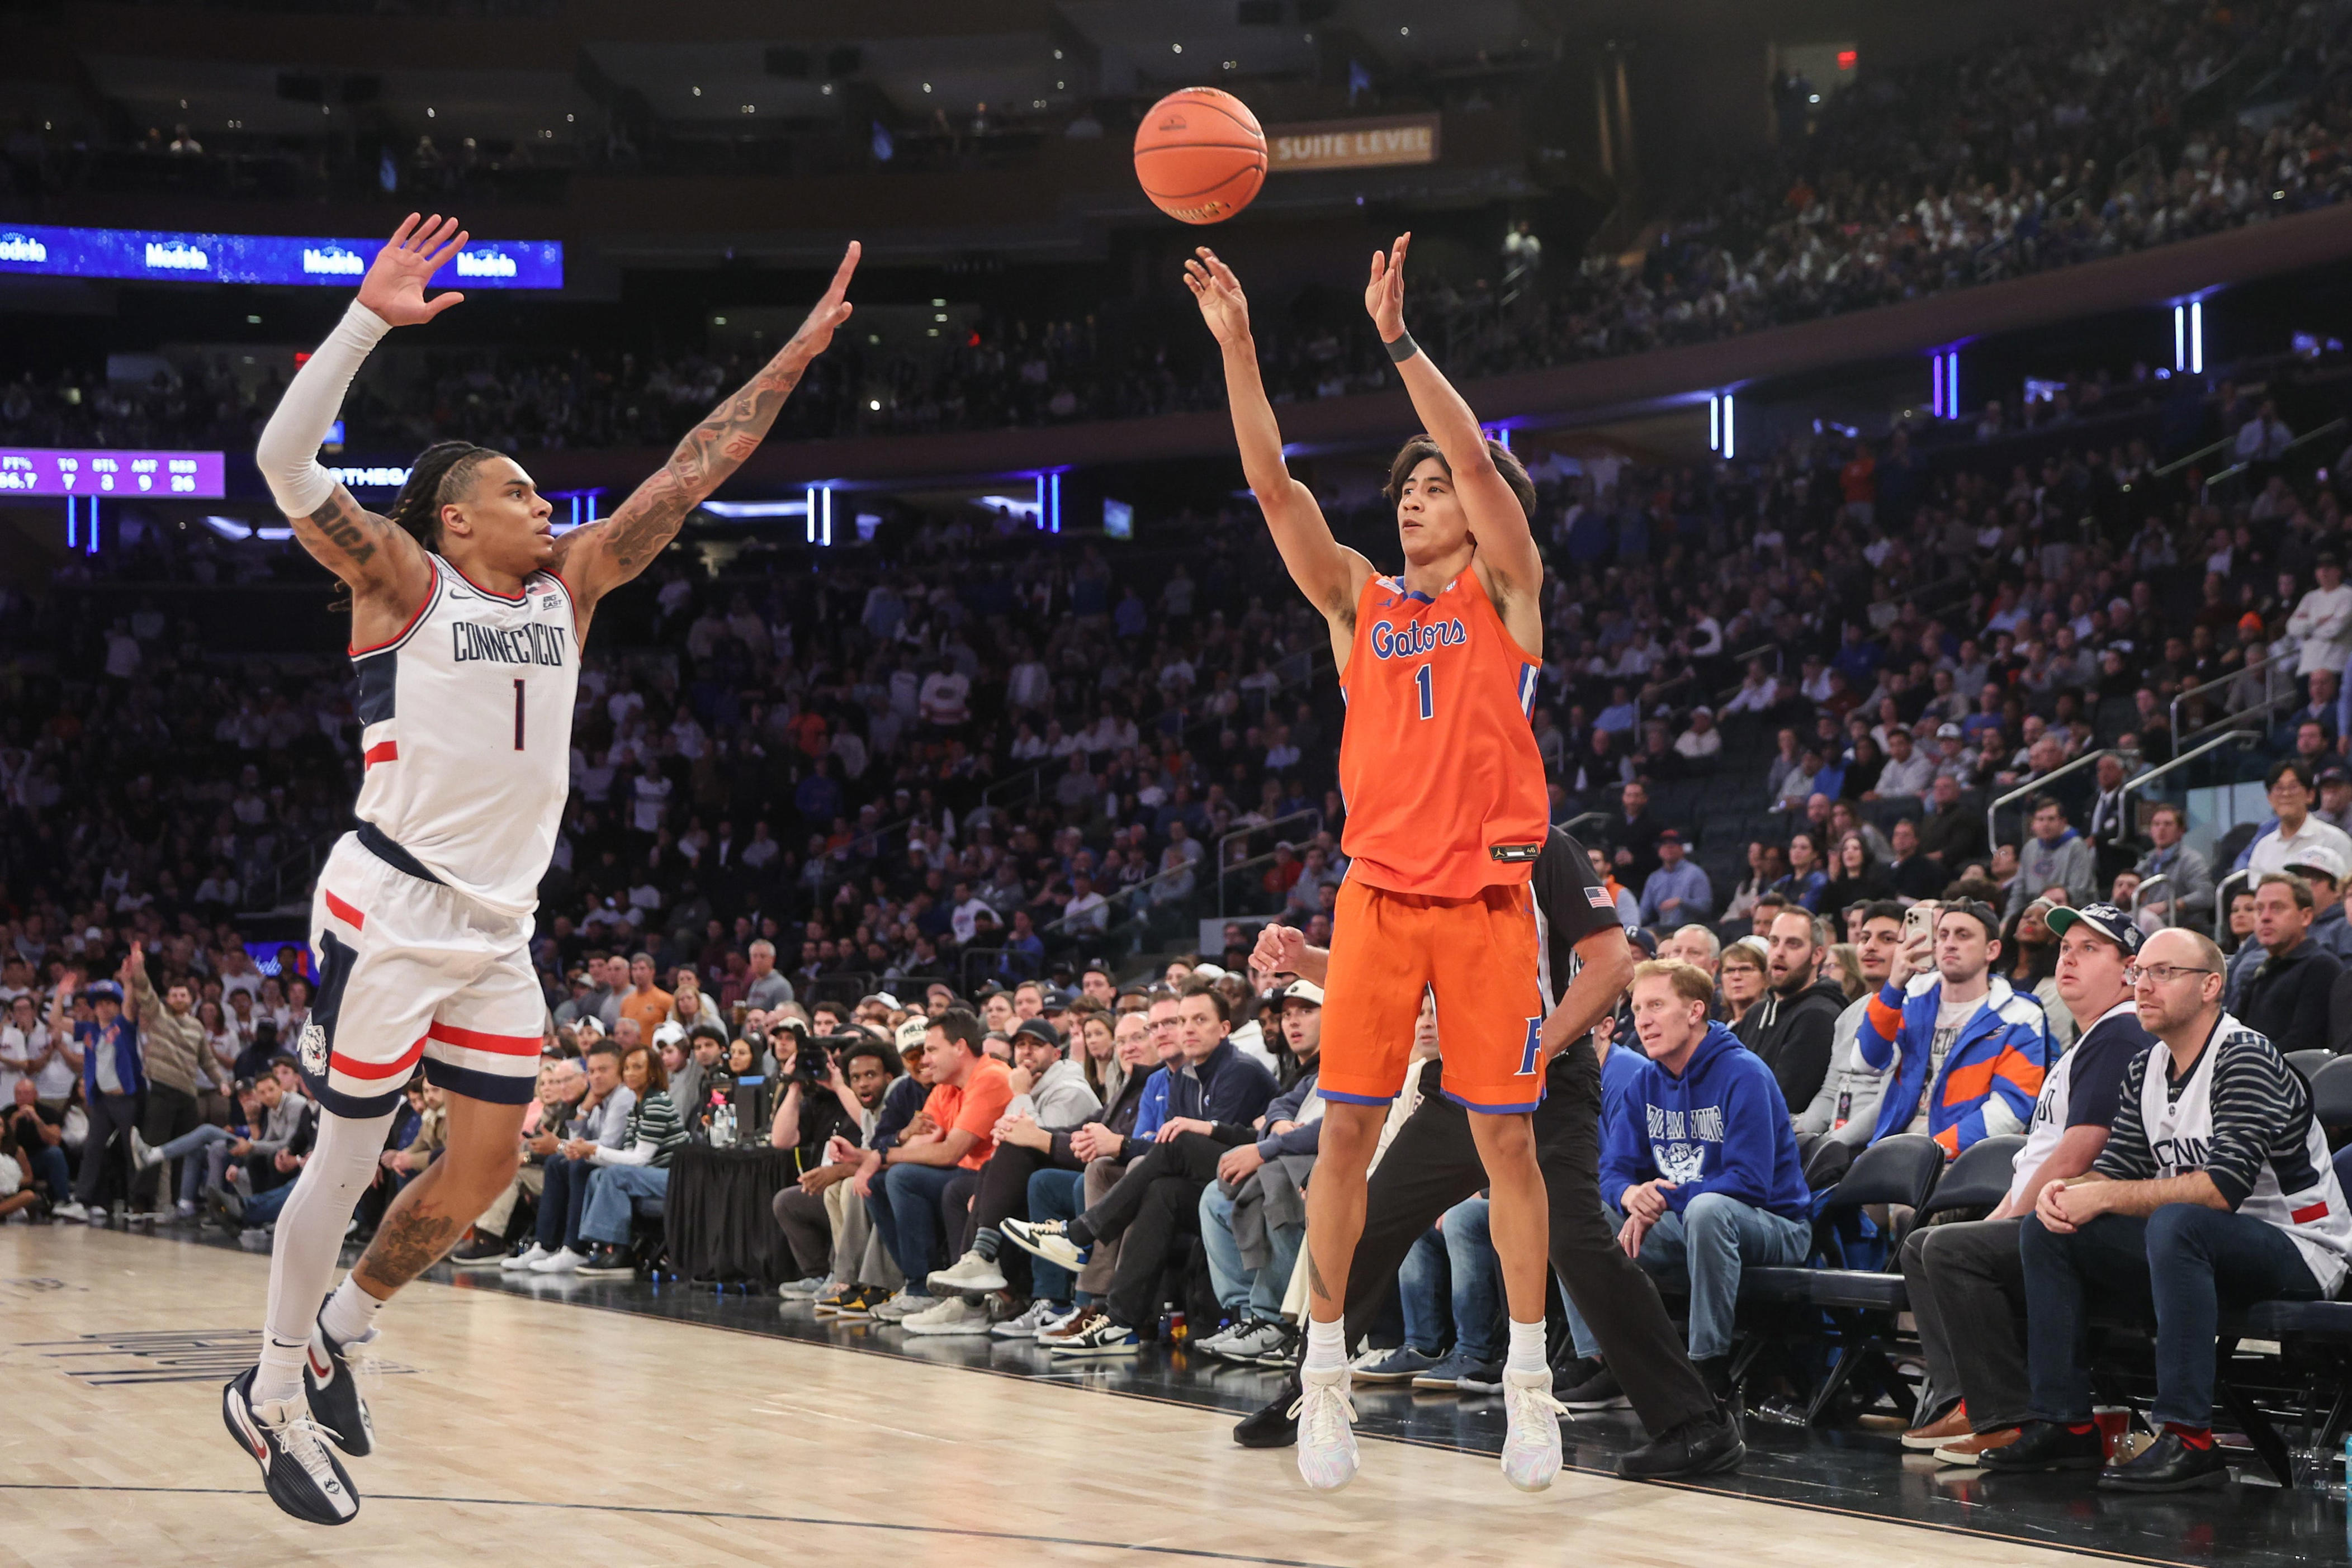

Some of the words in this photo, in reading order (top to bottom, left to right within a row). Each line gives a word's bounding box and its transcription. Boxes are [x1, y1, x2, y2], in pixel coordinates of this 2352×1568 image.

[1278, 134, 1346, 160] SUITE
[1355, 127, 1430, 155] LEVEL
[0, 238, 48, 262] odelo
[146, 243, 208, 270] Modelo
[303, 249, 365, 274] Modelo
[457, 252, 518, 277] Modelo
[3, 456, 33, 470] FT%
[57, 458, 79, 472] TO
[92, 458, 119, 472] STL
[131, 459, 159, 473] AST
[169, 459, 197, 473] REB
[62, 473, 76, 490] 7
[101, 473, 115, 491] 3
[138, 474, 152, 491] 9
[171, 475, 196, 492] 26
[543, 599, 563, 608] EAST
[453, 621, 565, 666] CONNECTICUT
[1371, 618, 1466, 660] Gators
[1415, 663, 1433, 720] 1
[513, 679, 525, 751] 1
[1513, 1015, 1542, 1076] F
[1669, 1149, 1689, 1162] BYU
